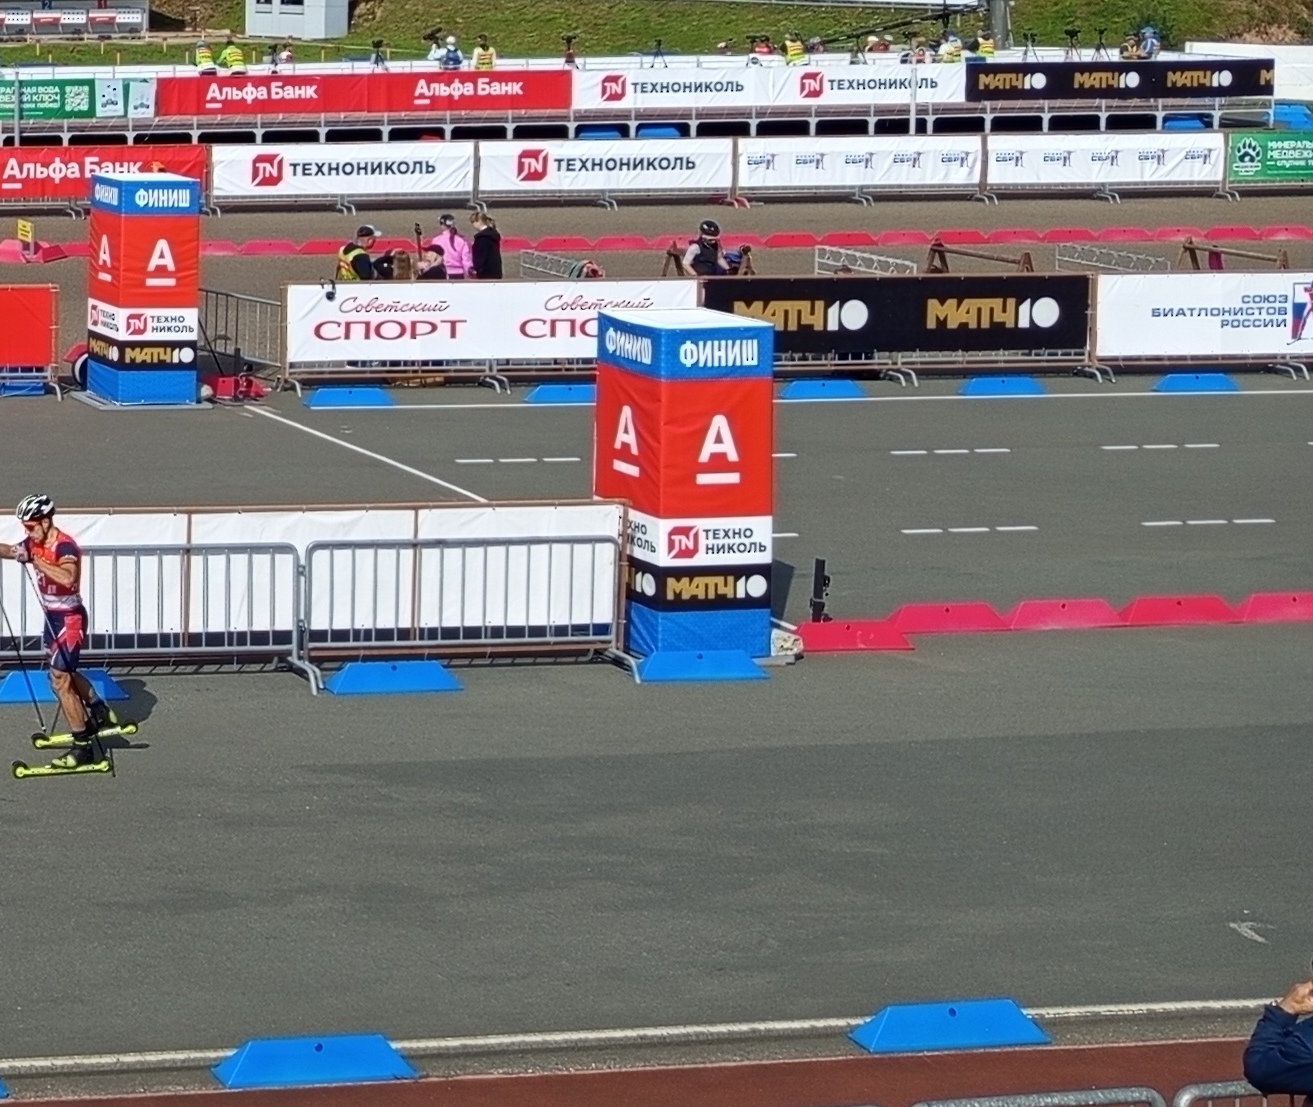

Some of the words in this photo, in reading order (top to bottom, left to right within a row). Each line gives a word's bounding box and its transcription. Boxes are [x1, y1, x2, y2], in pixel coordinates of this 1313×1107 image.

[206, 82, 268, 104] Альфа
[271, 82, 318, 100] Банк
[414, 78, 475, 100] Альфа
[477, 78, 524, 96] Банк
[631, 80, 744, 94] ТЕХНОНИКОЛЬ
[3, 157, 80, 186] Альфа
[84, 157, 144, 175] Банк
[289, 160, 436, 178] ТЕХНОНИКОЛЬ
[554, 156, 696, 172] ТЕХНОНИКОЛЬ
[94, 183, 118, 206] ФИНИШ
[134, 188, 190, 208] ФИНИШ
[338, 296, 450, 314] Советский
[1242, 294, 1288, 304] СОЮЗ
[150, 315, 185, 324] ТЕХНО
[1151, 306, 1288, 318] БИАТЛОНИСТОВ
[151, 324, 194, 334] НИКОЛЬ
[314, 319, 467, 340] СПОРТ
[519, 318, 598, 338] СПО
[1220, 318, 1288, 328] РОССИИ
[606, 327, 652, 366] ФИНИШ
[679, 339, 758, 368] ФИНИШ
[703, 528, 754, 540] ТЕХНО
[705, 540, 767, 554] НИКОЛЬ
